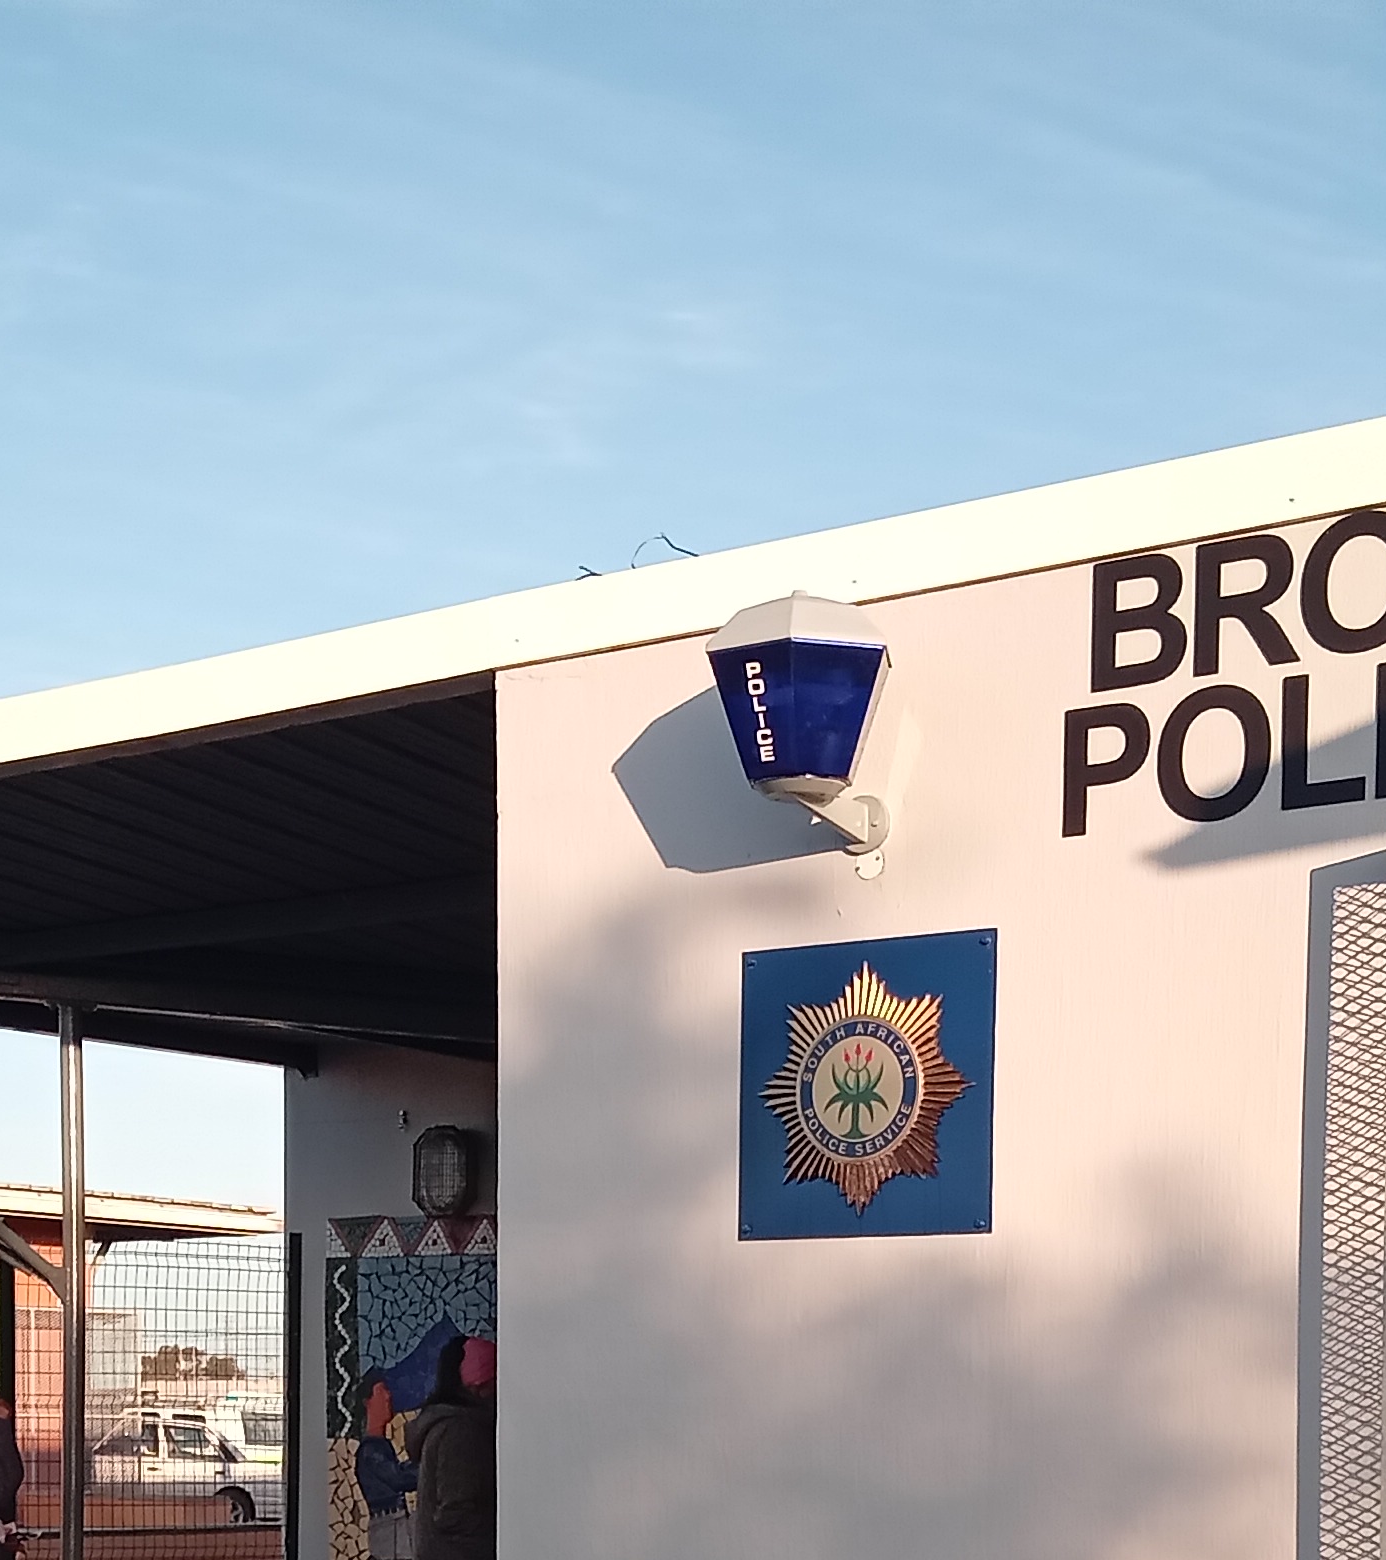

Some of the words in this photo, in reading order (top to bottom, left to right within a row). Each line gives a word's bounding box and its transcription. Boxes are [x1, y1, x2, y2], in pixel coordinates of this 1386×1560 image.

[745, 661, 776, 763] POLICE
[802, 1026, 847, 1083] SOUTH
[854, 1022, 916, 1080] AFRICAN
[802, 1108, 848, 1156] POLICE
[854, 1103, 912, 1157] SERVICE
